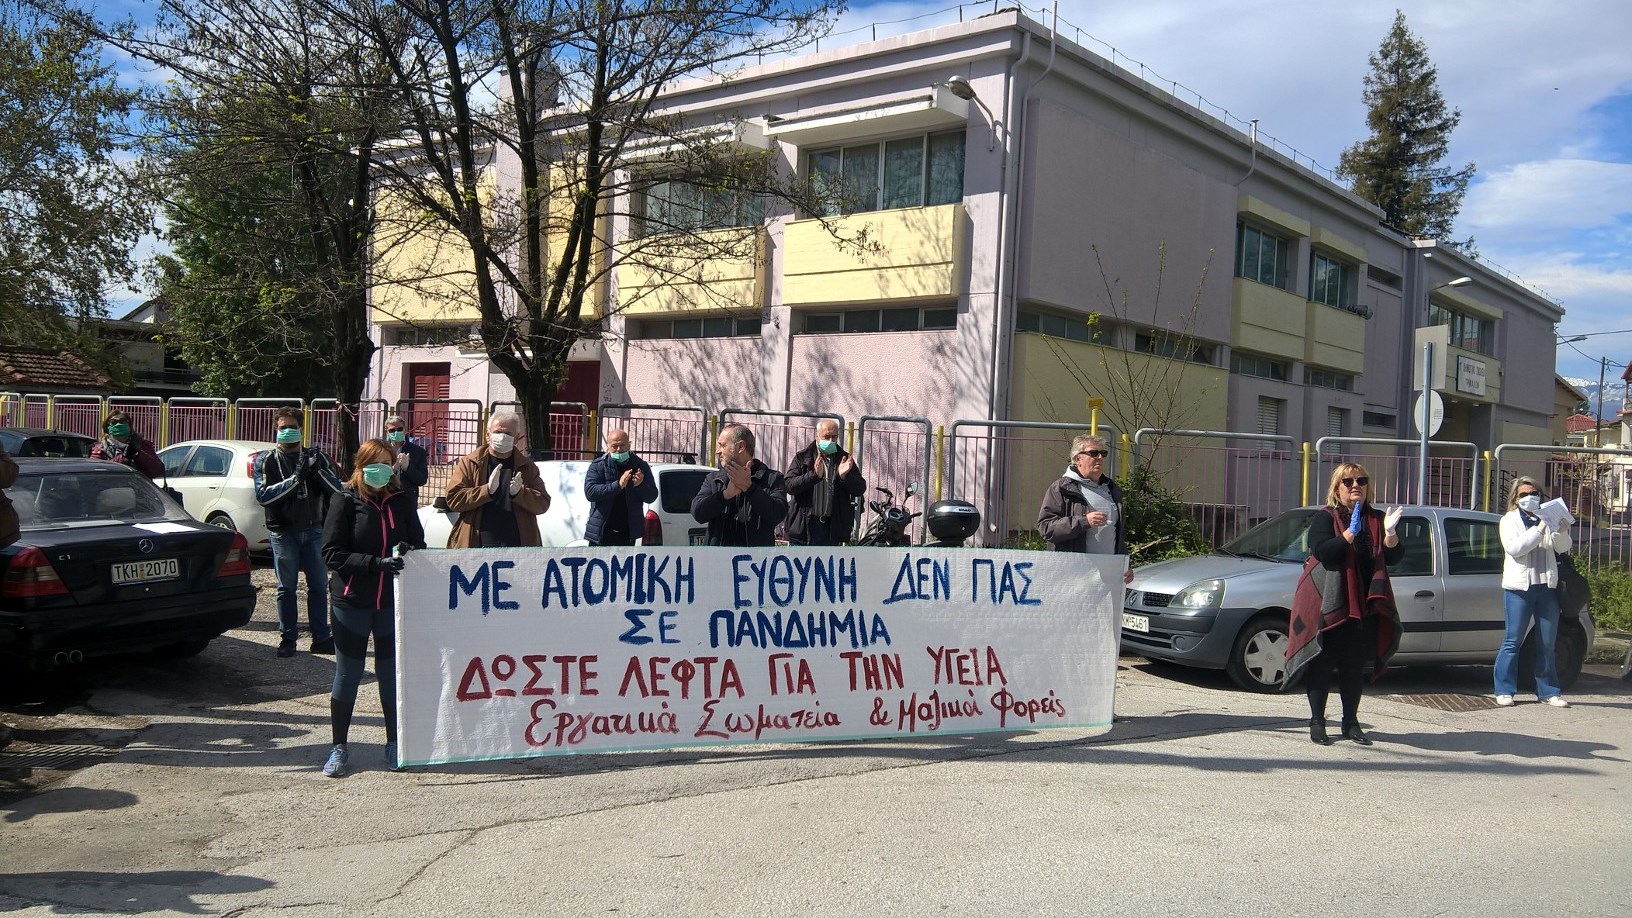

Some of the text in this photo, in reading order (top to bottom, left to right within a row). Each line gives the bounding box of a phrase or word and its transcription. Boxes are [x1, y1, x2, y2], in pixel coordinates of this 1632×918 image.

[449, 553, 1042, 616] ΜΕ ΑΤΟΜΙΚΗ ΕΥΘΥΝΗ ΔΕΝ ΠΑΣ
[618, 608, 891, 649] ΣΕ ΠΑΝΔΗΜΙΑ
[456, 645, 1008, 702] ΔΩΣΤΕ ΛΕΦΤΑ ΓΙΑ ΤΗΝ ΥΓΕΙΑ
[524, 699, 680, 748] Εργατικά
[694, 700, 842, 741] Σωματεία
[869, 697, 893, 726] &
[990, 687, 1066, 728] Φορείς
